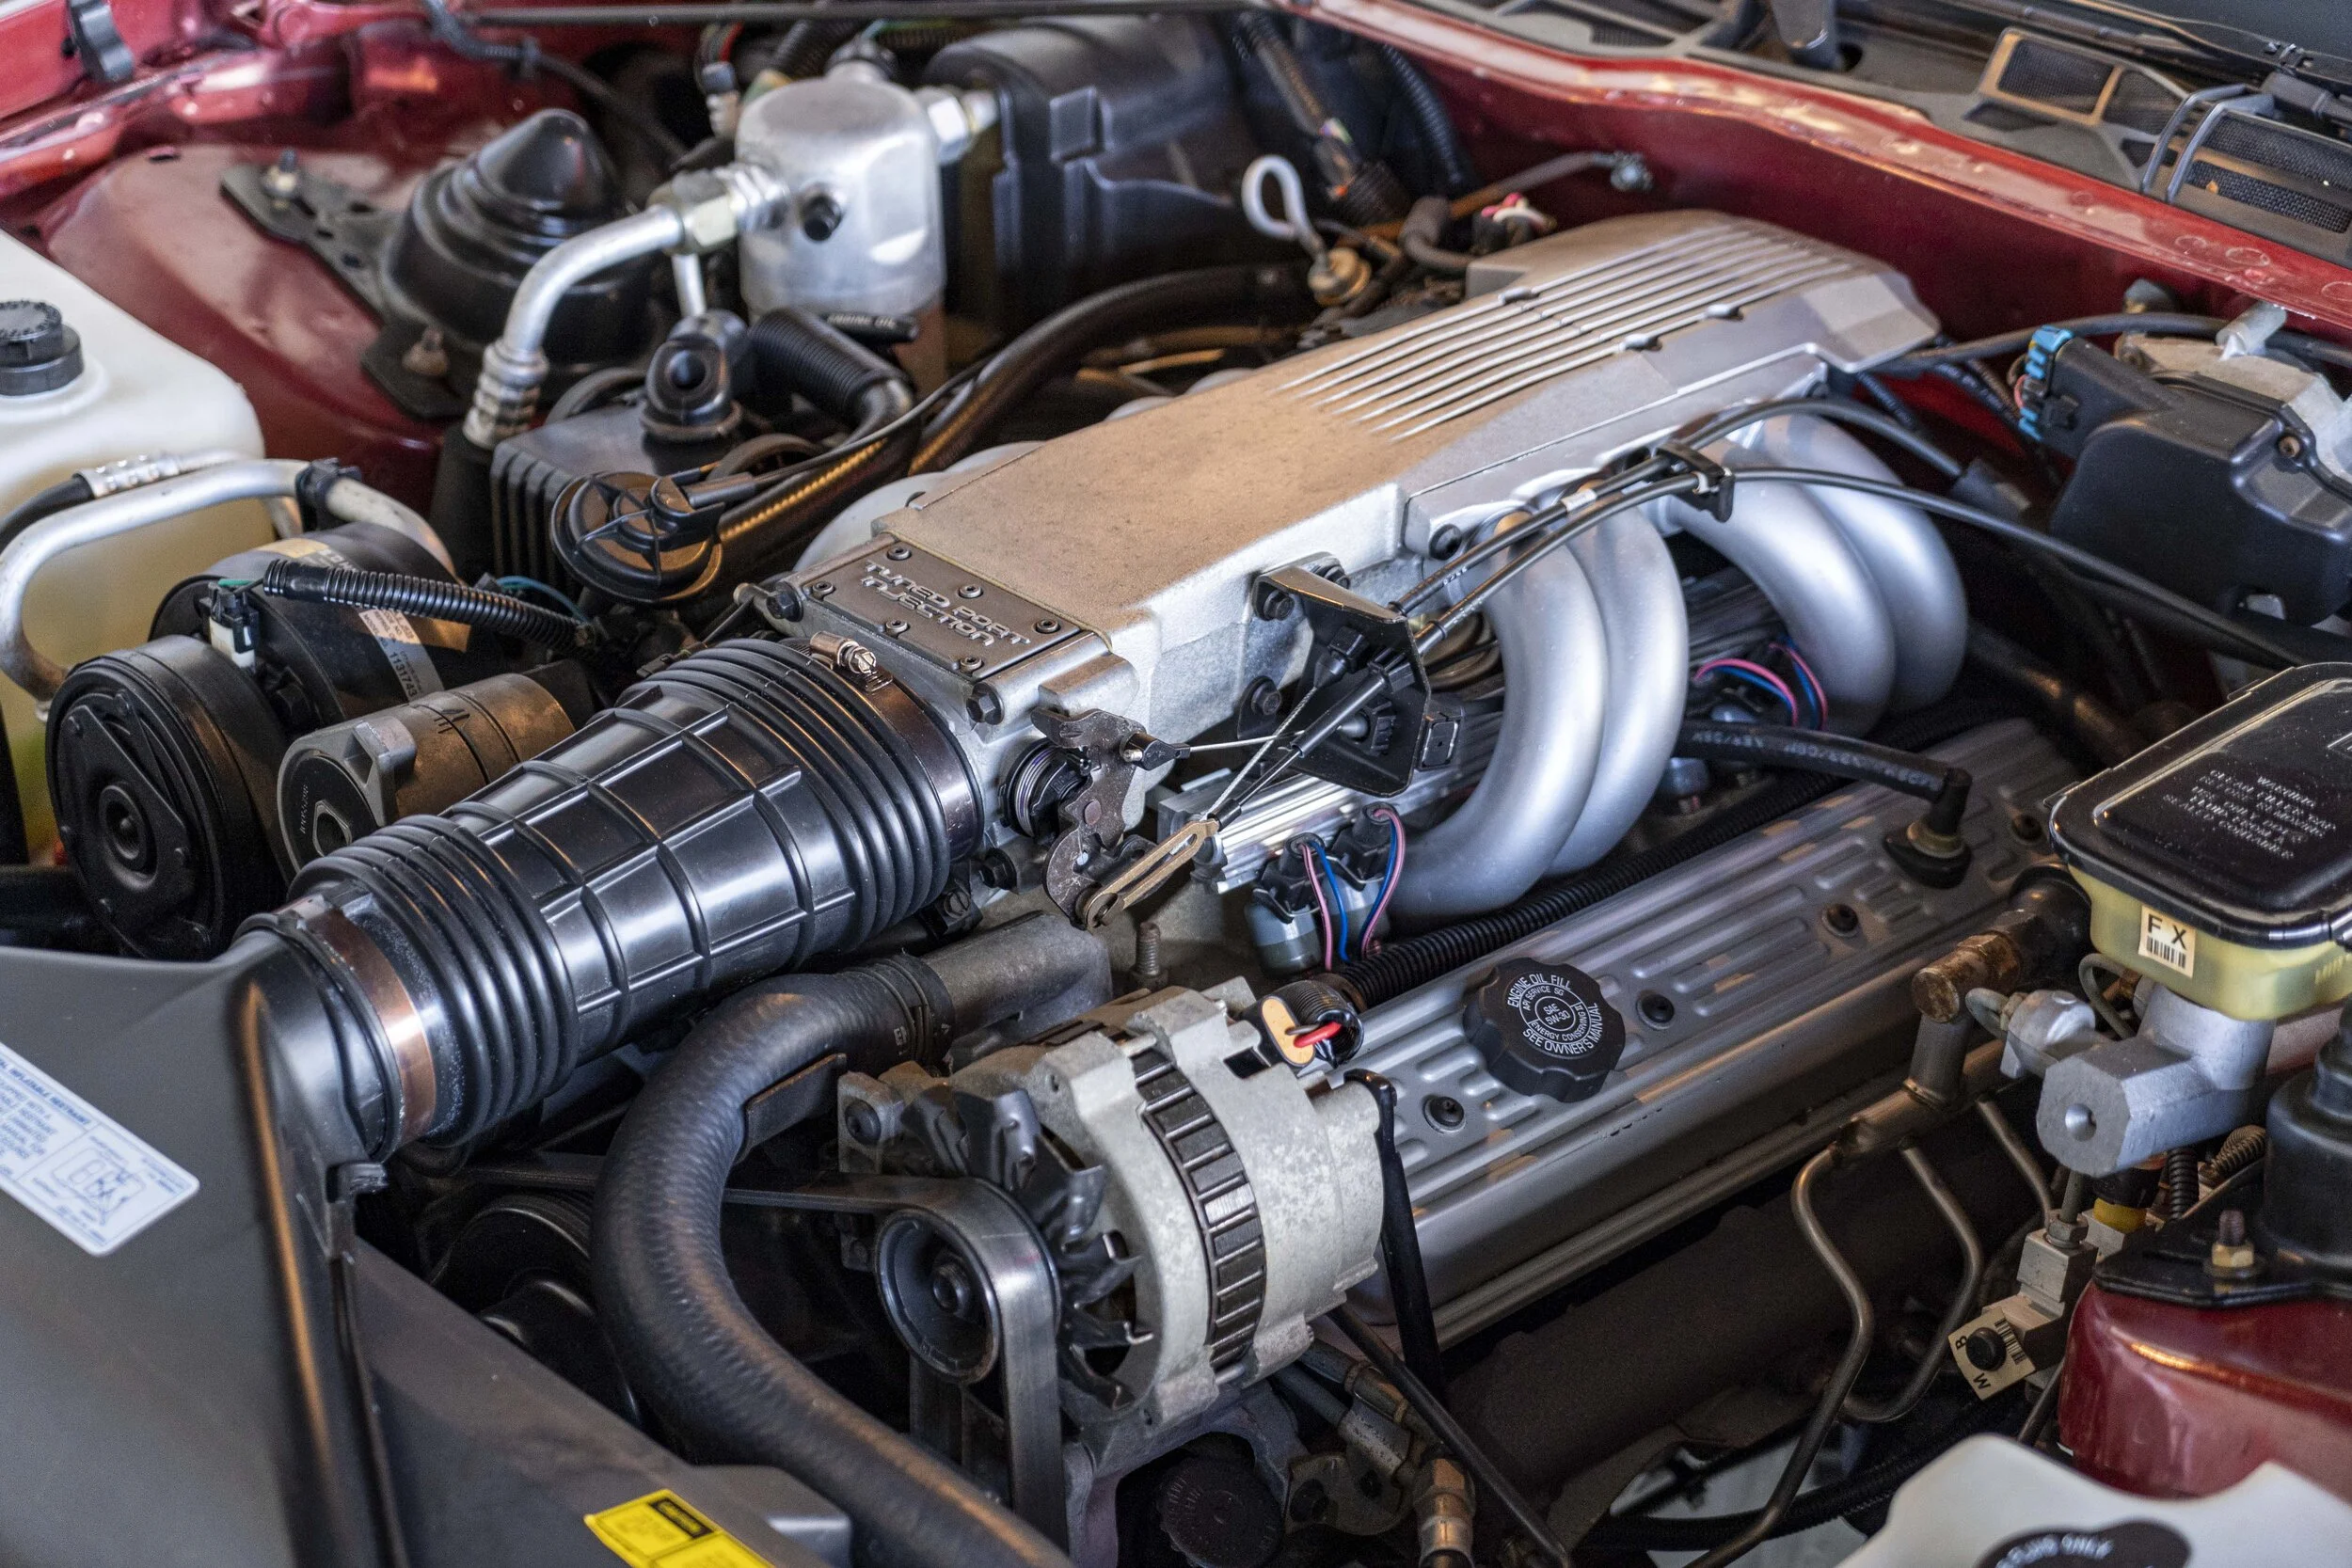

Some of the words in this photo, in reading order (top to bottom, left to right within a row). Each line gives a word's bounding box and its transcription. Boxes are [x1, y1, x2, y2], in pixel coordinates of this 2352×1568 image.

[861, 576, 994, 647] INJECTION
[865, 560, 950, 608] TUNED
[952, 605, 1031, 645] PORT
[389, 652, 419, 696] 1131743
[1507, 976, 1532, 1008] ENGINE
[1529, 973, 1548, 985] OIL
[1550, 974, 1571, 991] FILL
[1522, 1000, 1532, 1012] API
[1525, 985, 1551, 1001] SERVICE
[1553, 987, 1565, 997] SG
[1543, 1003, 1561, 1016] SAE
[1545, 1009, 1571, 1026] 5W-30
[1522, 1028, 1545, 1048] SEE
[1544, 1038, 1595, 1055] OWNER'S
[1588, 1002, 1603, 1044] MANUAL
[1531, 1020, 1560, 1040] ENERGY
[1561, 1011, 1588, 1042] CONSERVING
